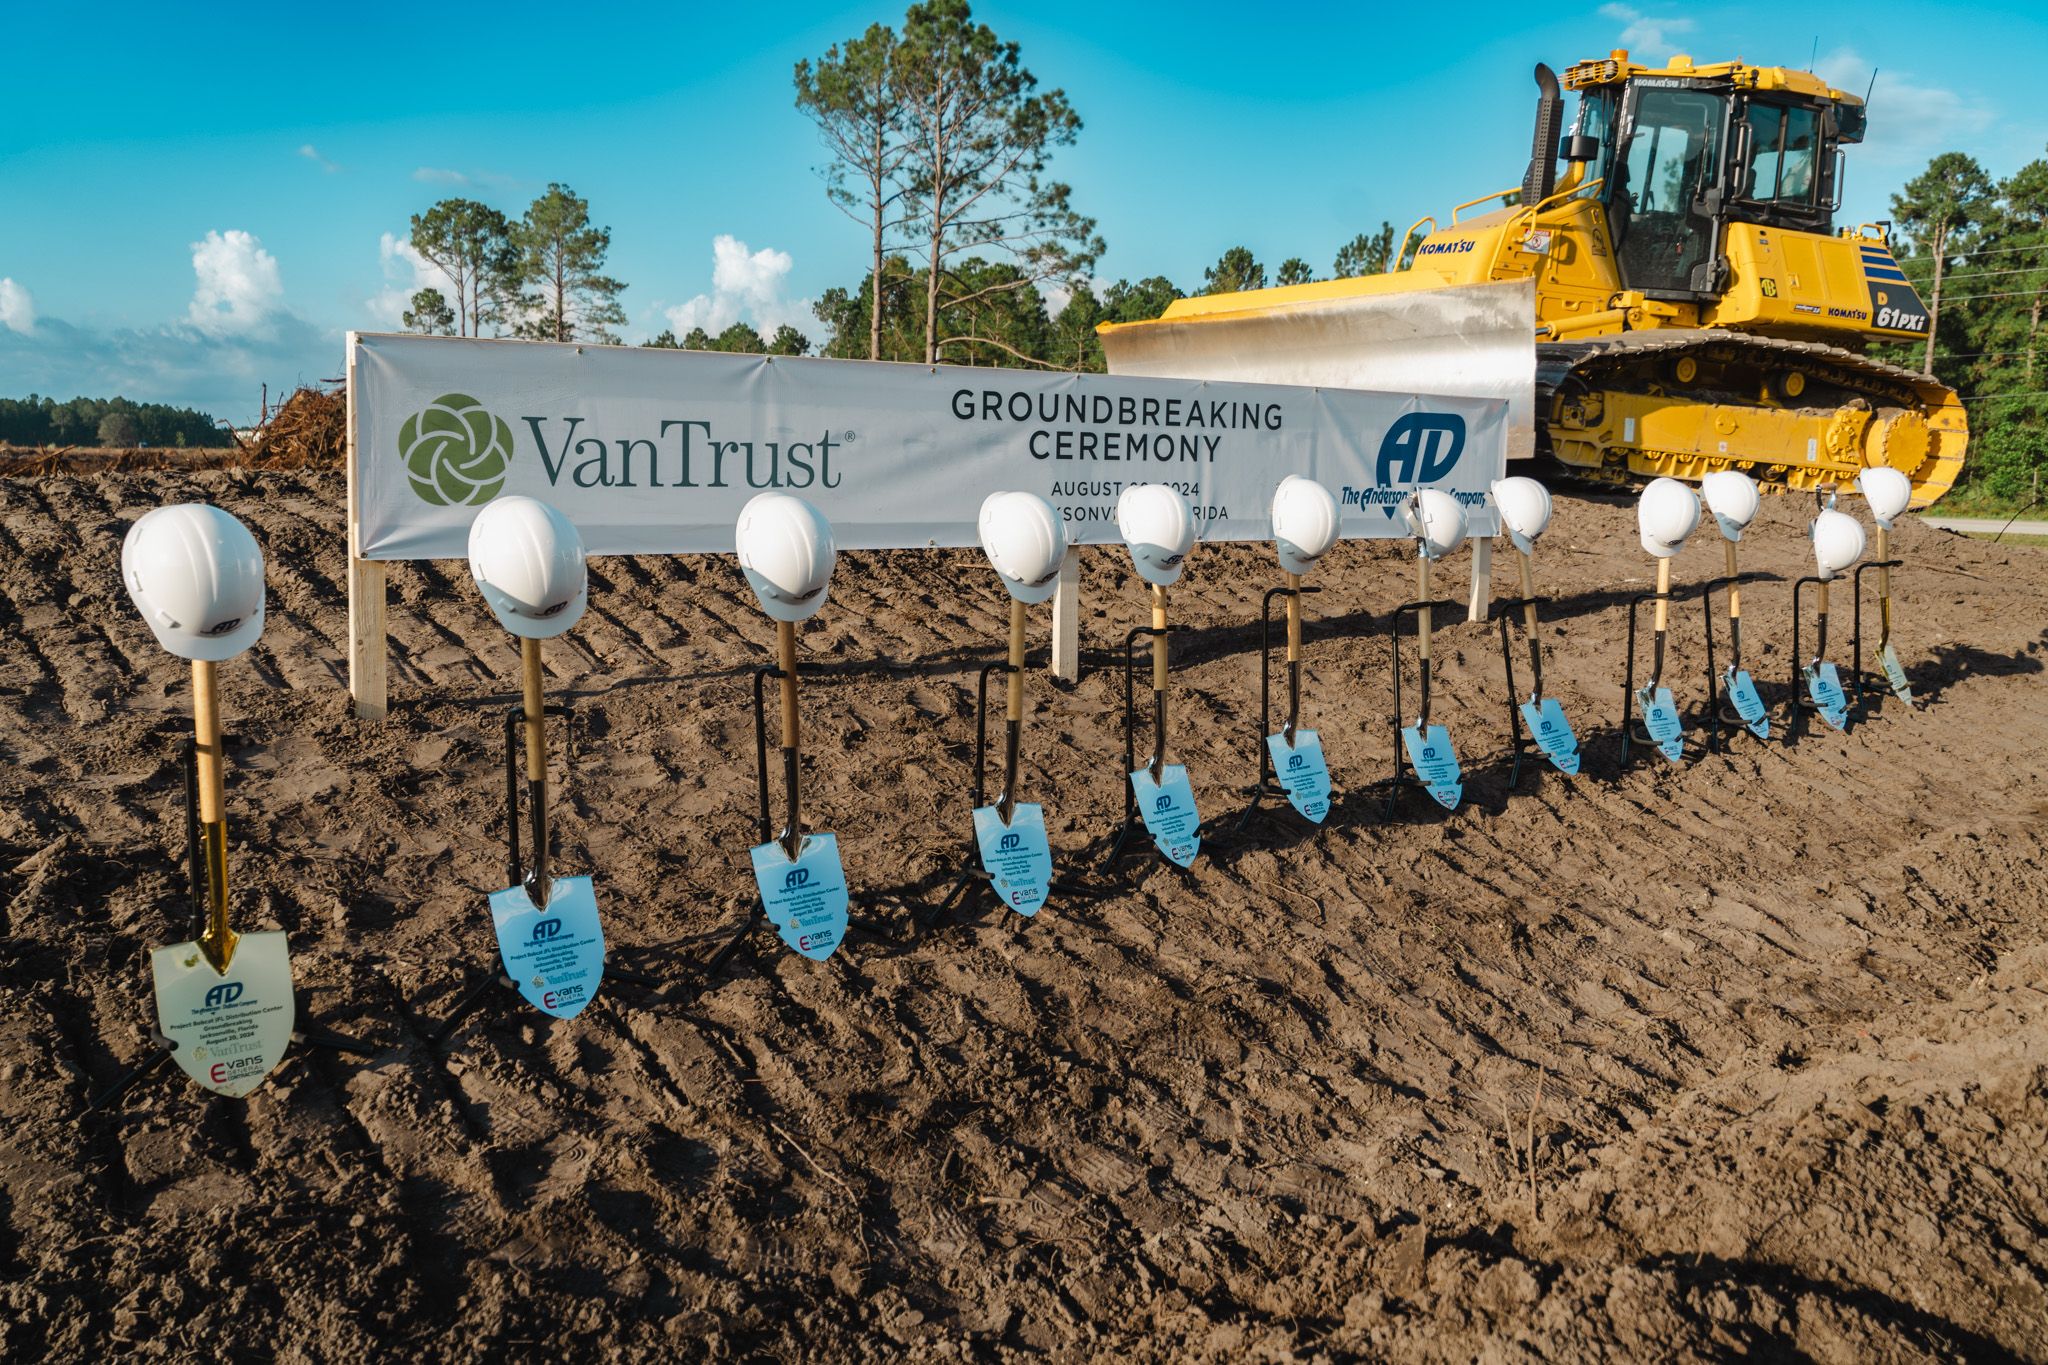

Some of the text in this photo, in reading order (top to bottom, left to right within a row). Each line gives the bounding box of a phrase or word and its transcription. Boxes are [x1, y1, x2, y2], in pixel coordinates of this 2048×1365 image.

[1634, 79, 1679, 88] KOMATSU
[1419, 240, 1475, 255] KOMATSU
[1877, 291, 1888, 306] D
[1828, 308, 1867, 320] KOMATSU
[1877, 307, 1925, 331] 61PXi
[951, 388, 1282, 431] GROUNDBREAKING
[1029, 430, 1222, 462] CEREMONY
[1376, 411, 1466, 489] AD
[1051, 481, 1199, 497] AUGUST 024
[1341, 487, 1359, 505] The
[1361, 486, 1408, 512] Anderson
[785, 868, 809, 889] AD
[533, 918, 562, 941] AD
[205, 981, 244, 1007] AD
[543, 984, 584, 1010] Evans
[262, 1005, 283, 1014] Center
[203, 1018, 253, 1032] Groundbreaking
[206, 1036, 228, 1046] August
[211, 1055, 264, 1084] Evans
